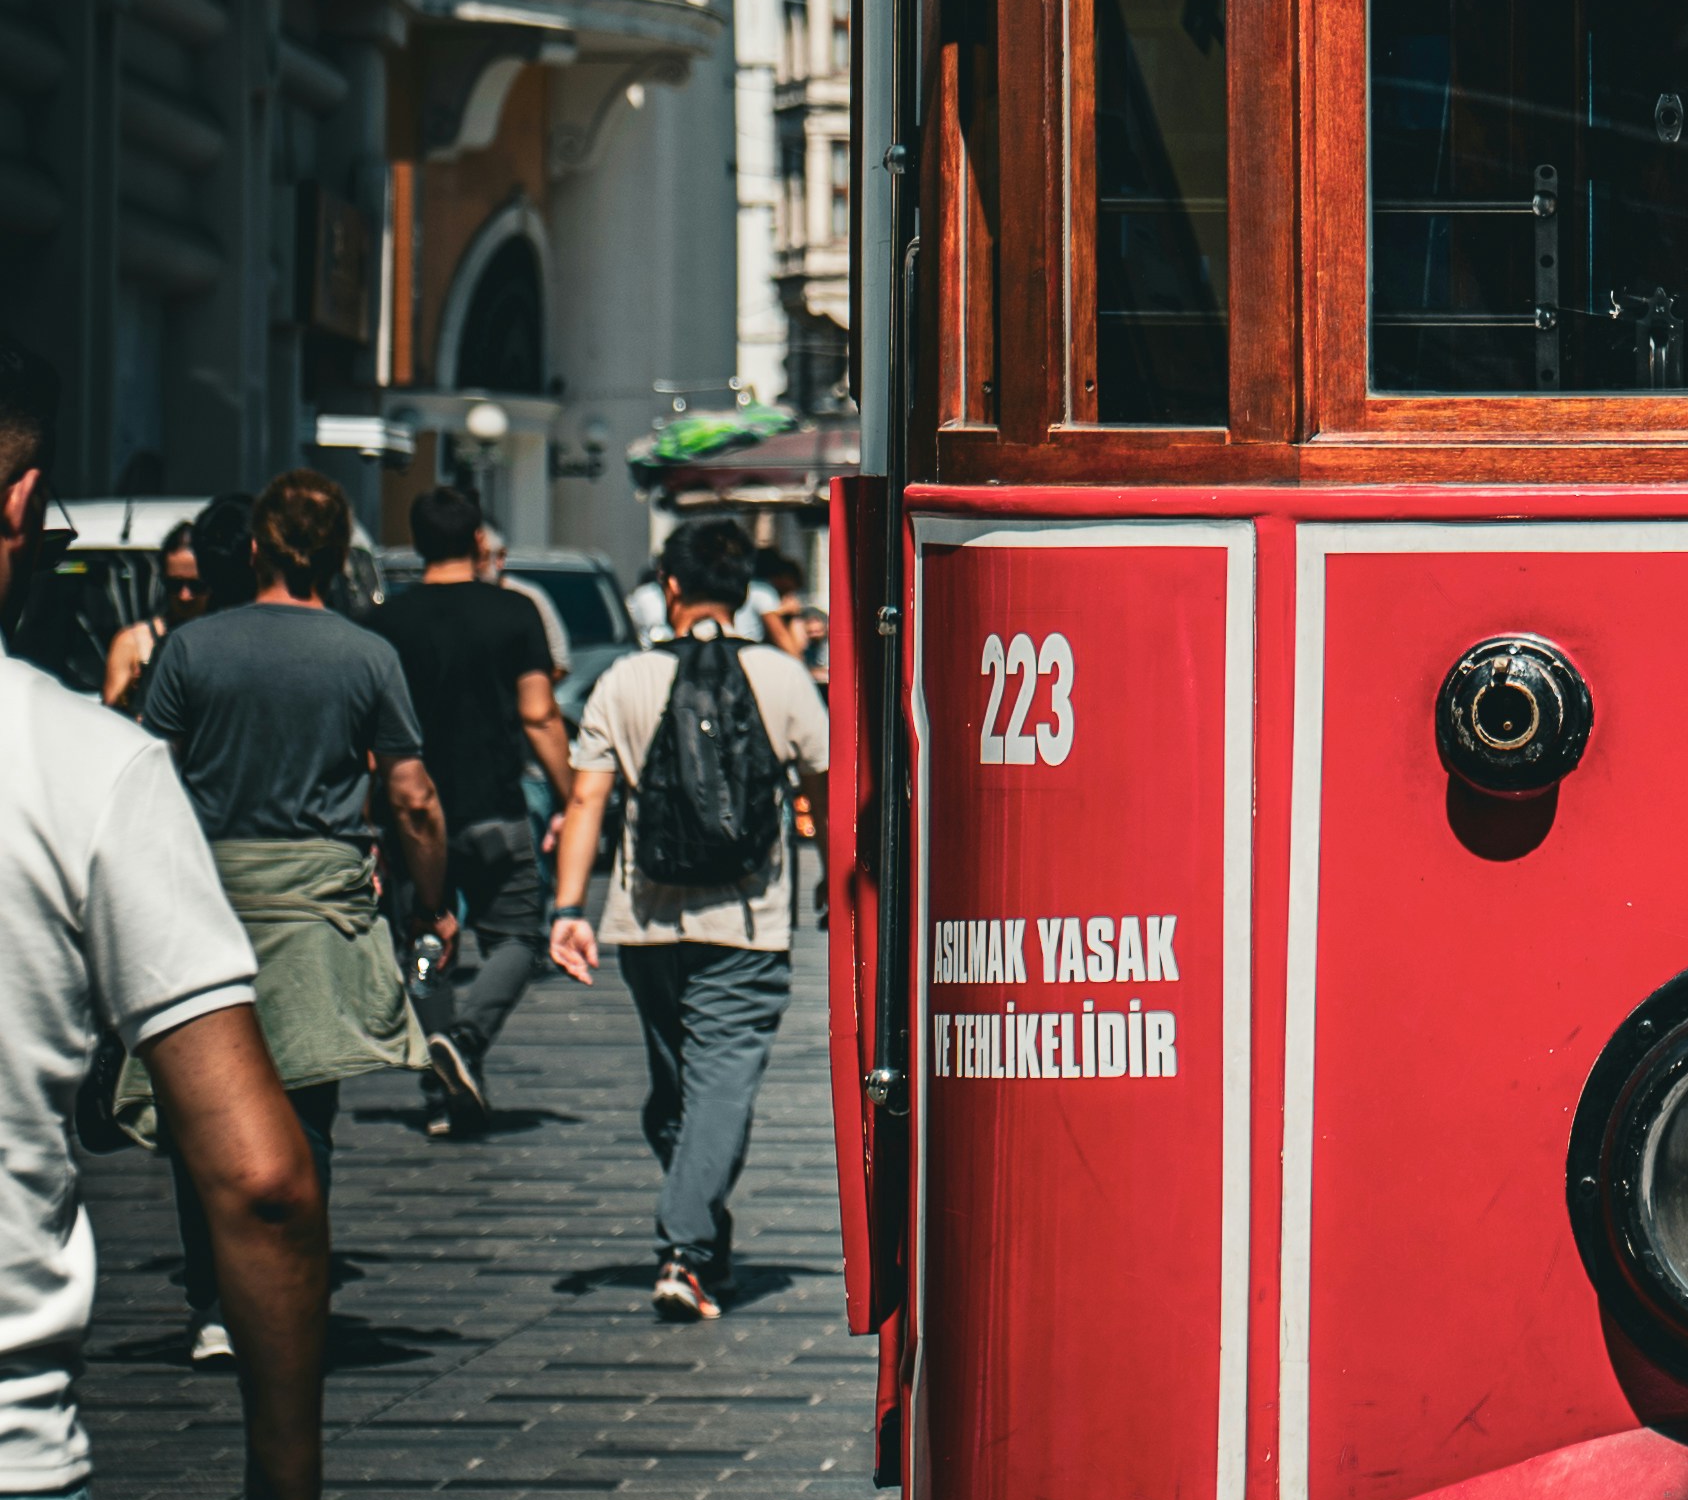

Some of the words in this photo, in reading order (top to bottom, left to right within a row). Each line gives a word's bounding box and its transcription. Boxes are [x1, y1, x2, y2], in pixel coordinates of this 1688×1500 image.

[980, 632, 1075, 767] 223
[933, 917, 1027, 984] ASILMAK
[1036, 914, 1180, 984] YASAK
[934, 1014, 951, 1078] VE
[954, 998, 1178, 1079] TEHLİKELİDİR
